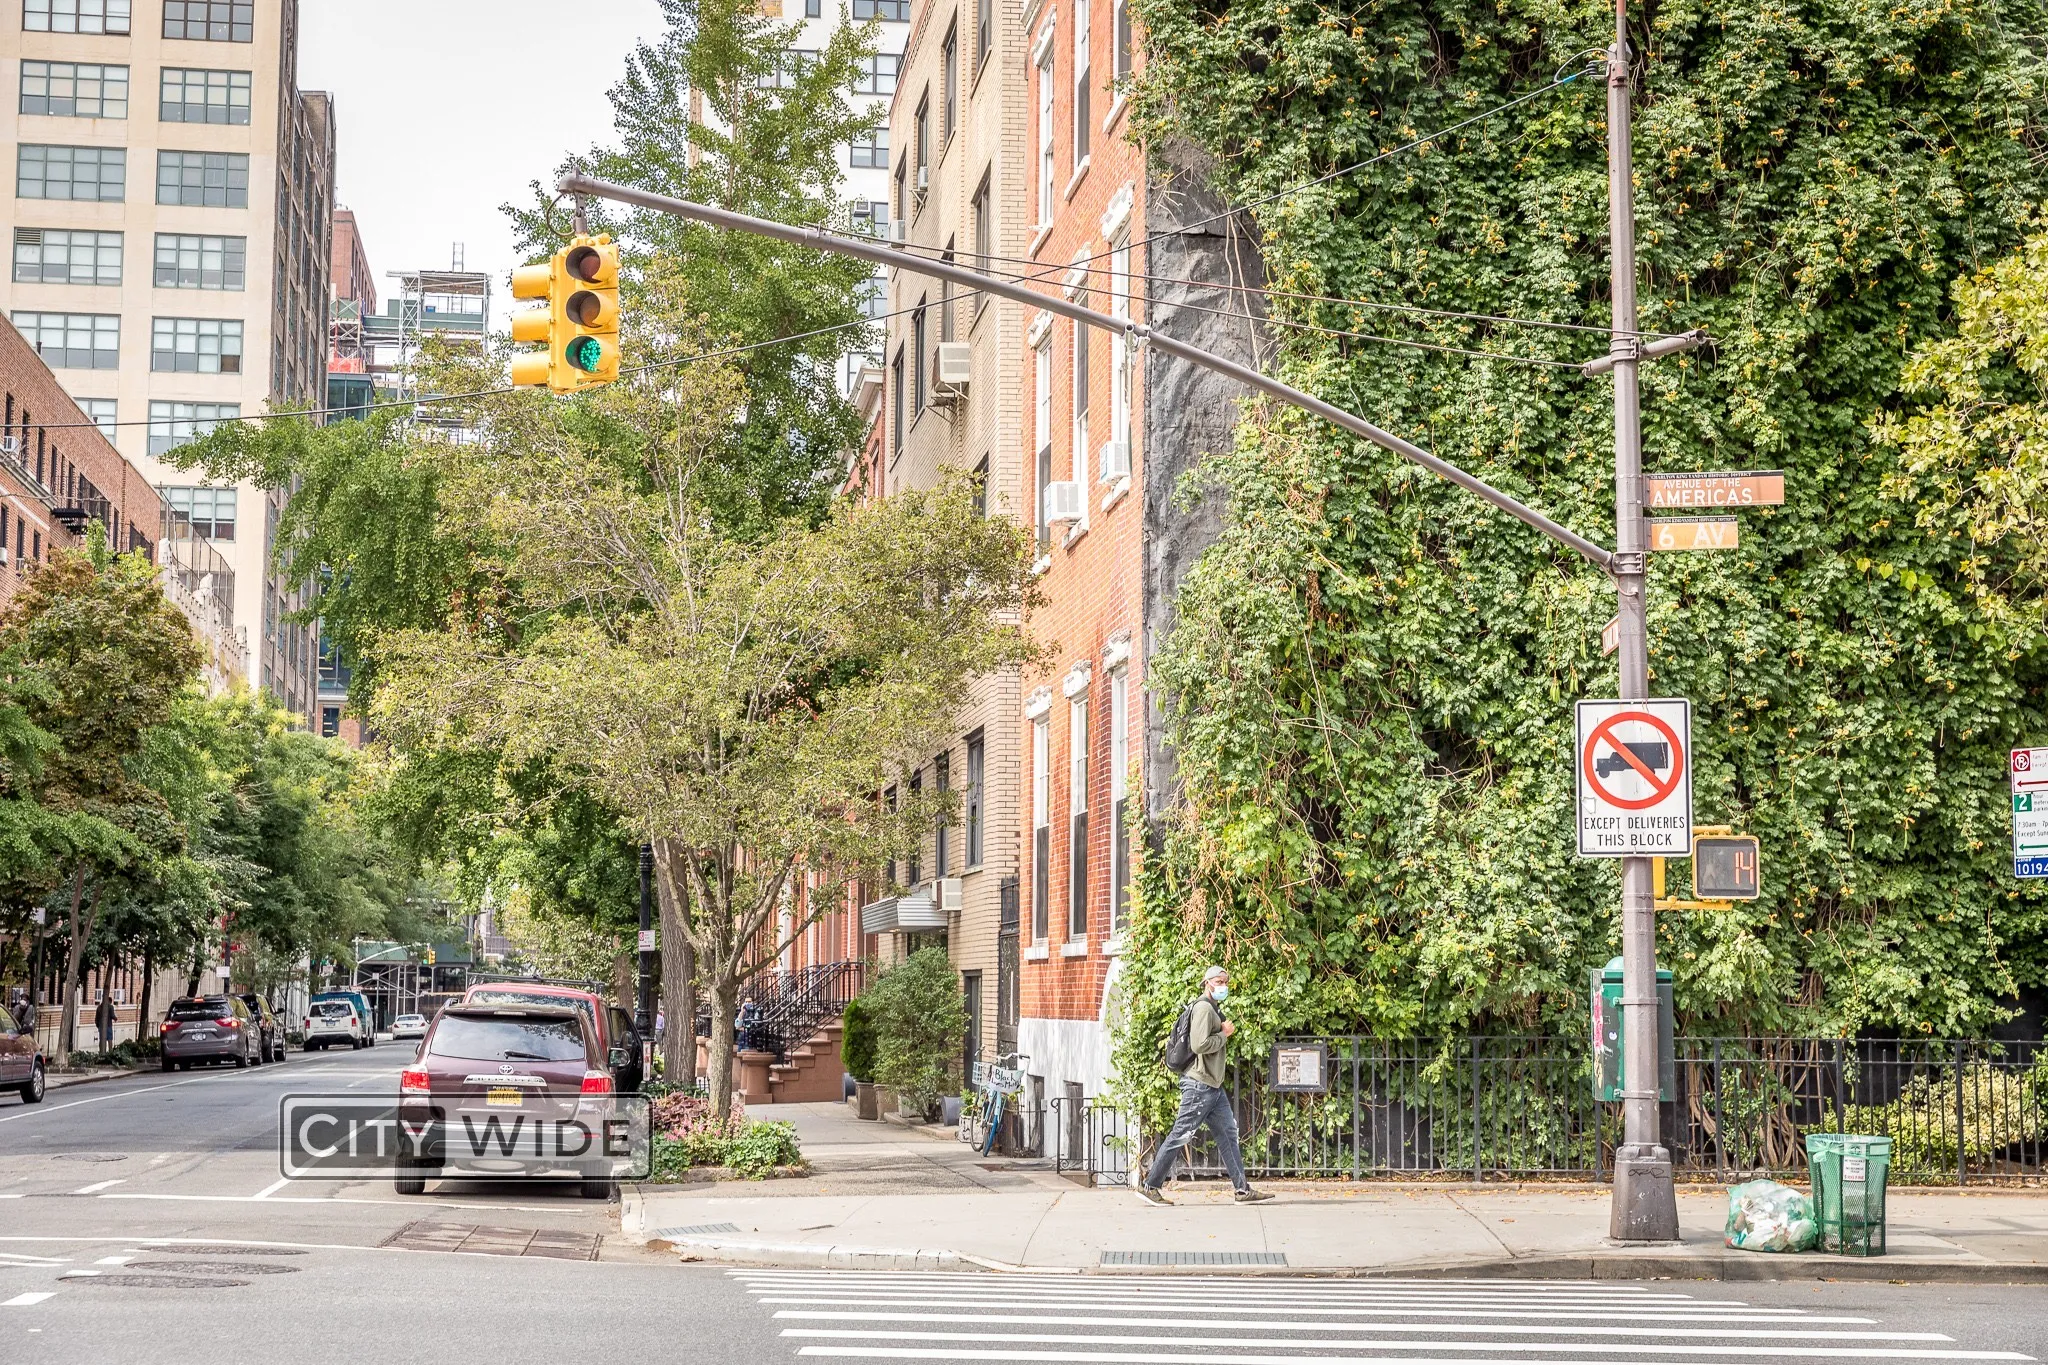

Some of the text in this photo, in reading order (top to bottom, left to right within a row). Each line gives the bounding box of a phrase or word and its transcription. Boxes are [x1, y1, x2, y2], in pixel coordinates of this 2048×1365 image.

[1664, 477, 1740, 488] AVENUE OF THE
[1652, 488, 1753, 506] AMERICAS
[1659, 523, 1727, 547] 6 AV
[2019, 794, 2027, 810] 2
[1584, 816, 1685, 829] EXCEPT DELIVERIES
[1597, 833, 1672, 846] THIS BLOCK
[1735, 851, 1754, 885] 14
[995, 1069, 1015, 1081] Black
